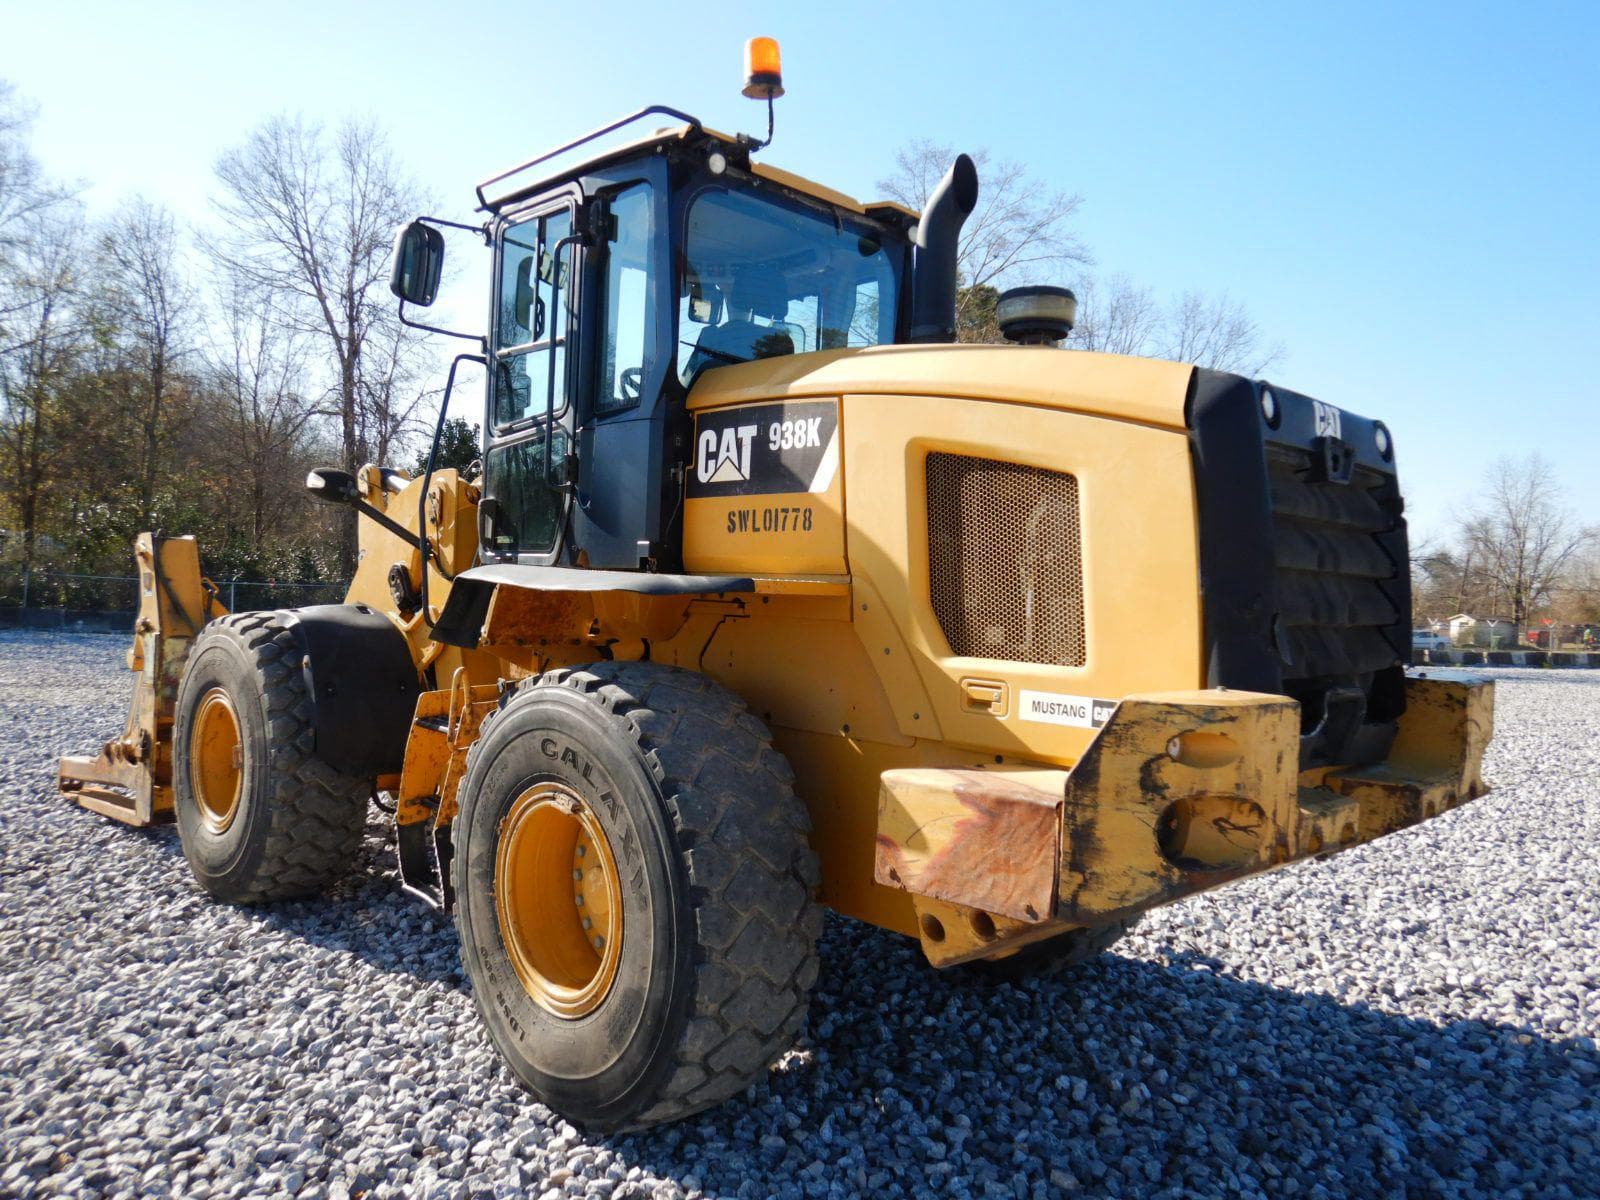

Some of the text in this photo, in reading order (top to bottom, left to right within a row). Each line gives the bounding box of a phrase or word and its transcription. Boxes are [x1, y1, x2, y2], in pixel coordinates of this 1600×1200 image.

[1312, 400, 1342, 440] CAT
[697, 417, 822, 483] CAT 938K
[727, 507, 813, 534] SWL01778
[1031, 699, 1086, 719] MUSTANG
[540, 737, 648, 910] GALAXY
